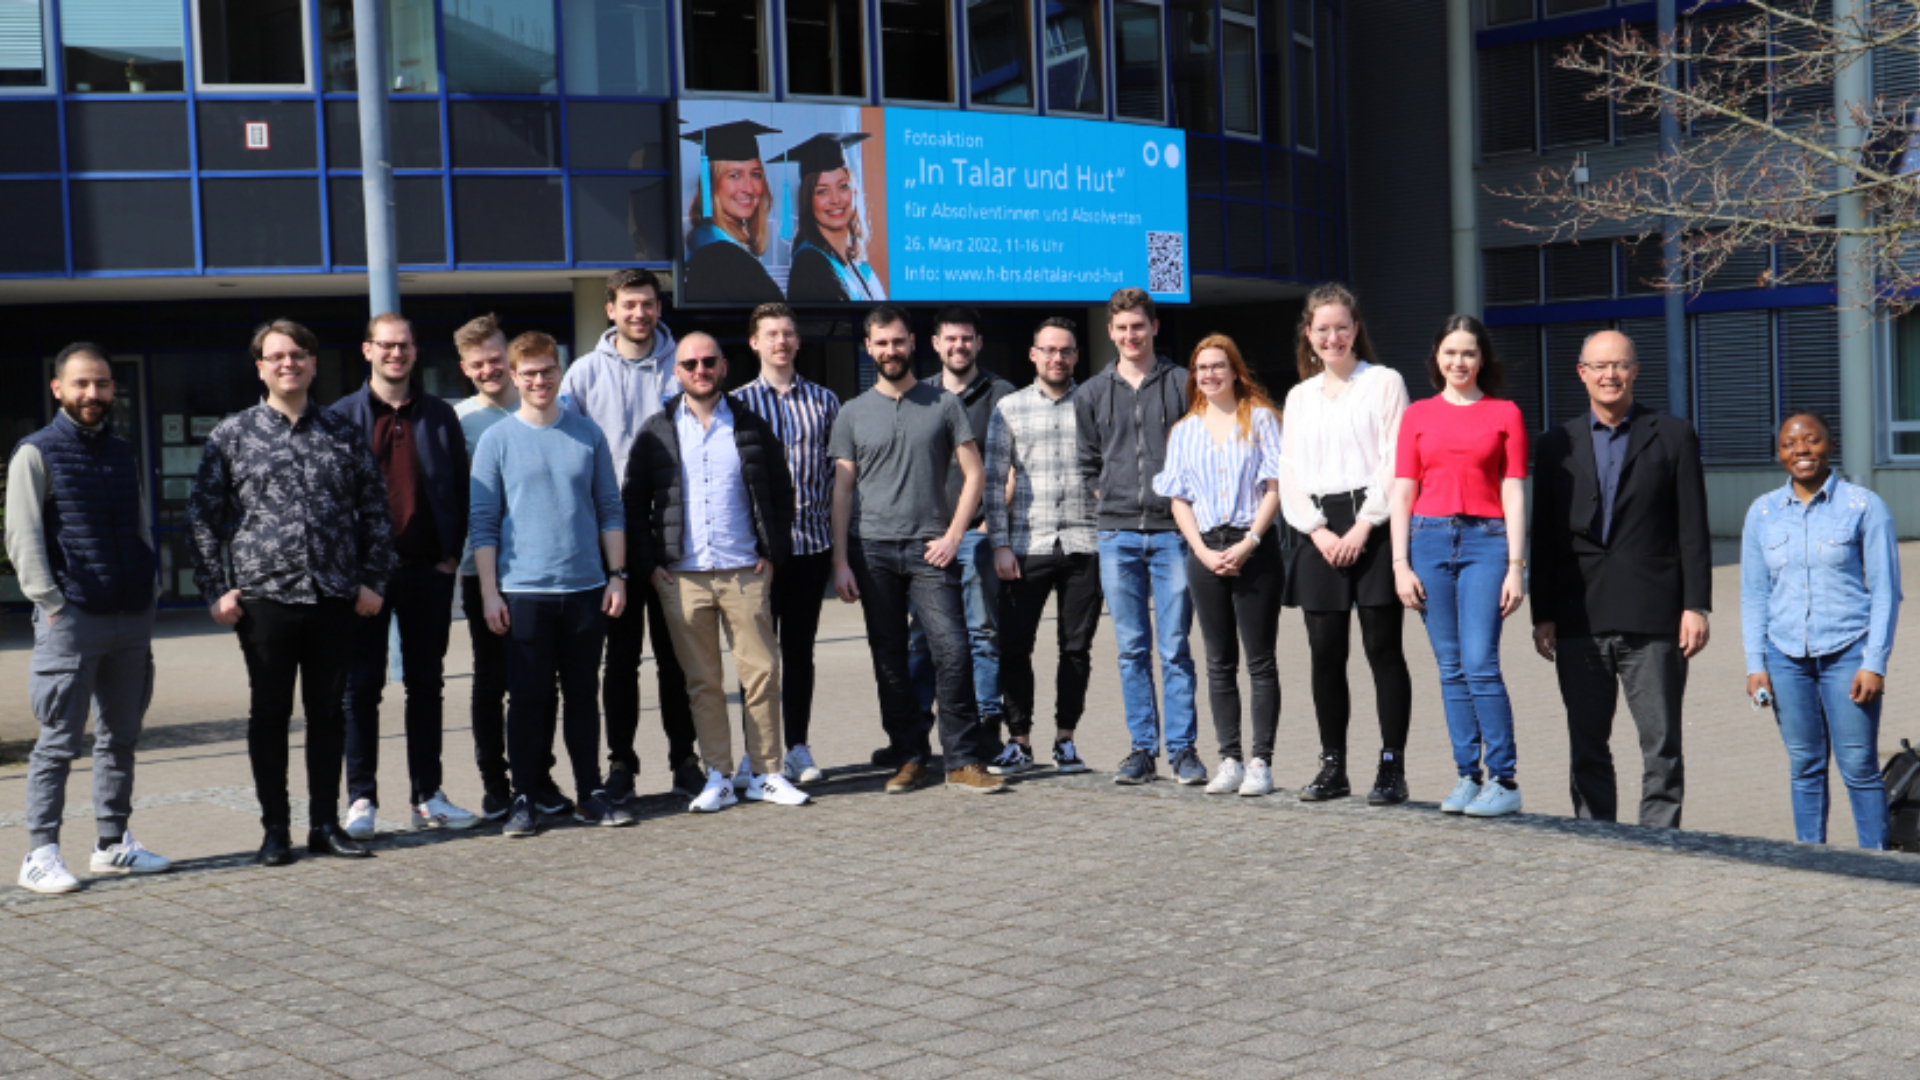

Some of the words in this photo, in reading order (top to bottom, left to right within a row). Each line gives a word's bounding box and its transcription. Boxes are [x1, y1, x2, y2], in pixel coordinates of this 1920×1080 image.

[904, 128, 983, 149] Fotoaktion
[951, 157, 1017, 188] Talar
[1023, 162, 1069, 191] und
[904, 200, 928, 218] für
[931, 202, 1040, 222] Absolventinnen
[1043, 206, 1068, 223] und
[1071, 207, 1143, 226] Absolventen
[904, 234, 926, 252] 26.
[928, 235, 964, 253] März
[966, 236, 1003, 255] 2022,
[1005, 237, 1040, 254] 11-16
[1042, 237, 1065, 254] Uhr
[904, 264, 940, 282] Info:
